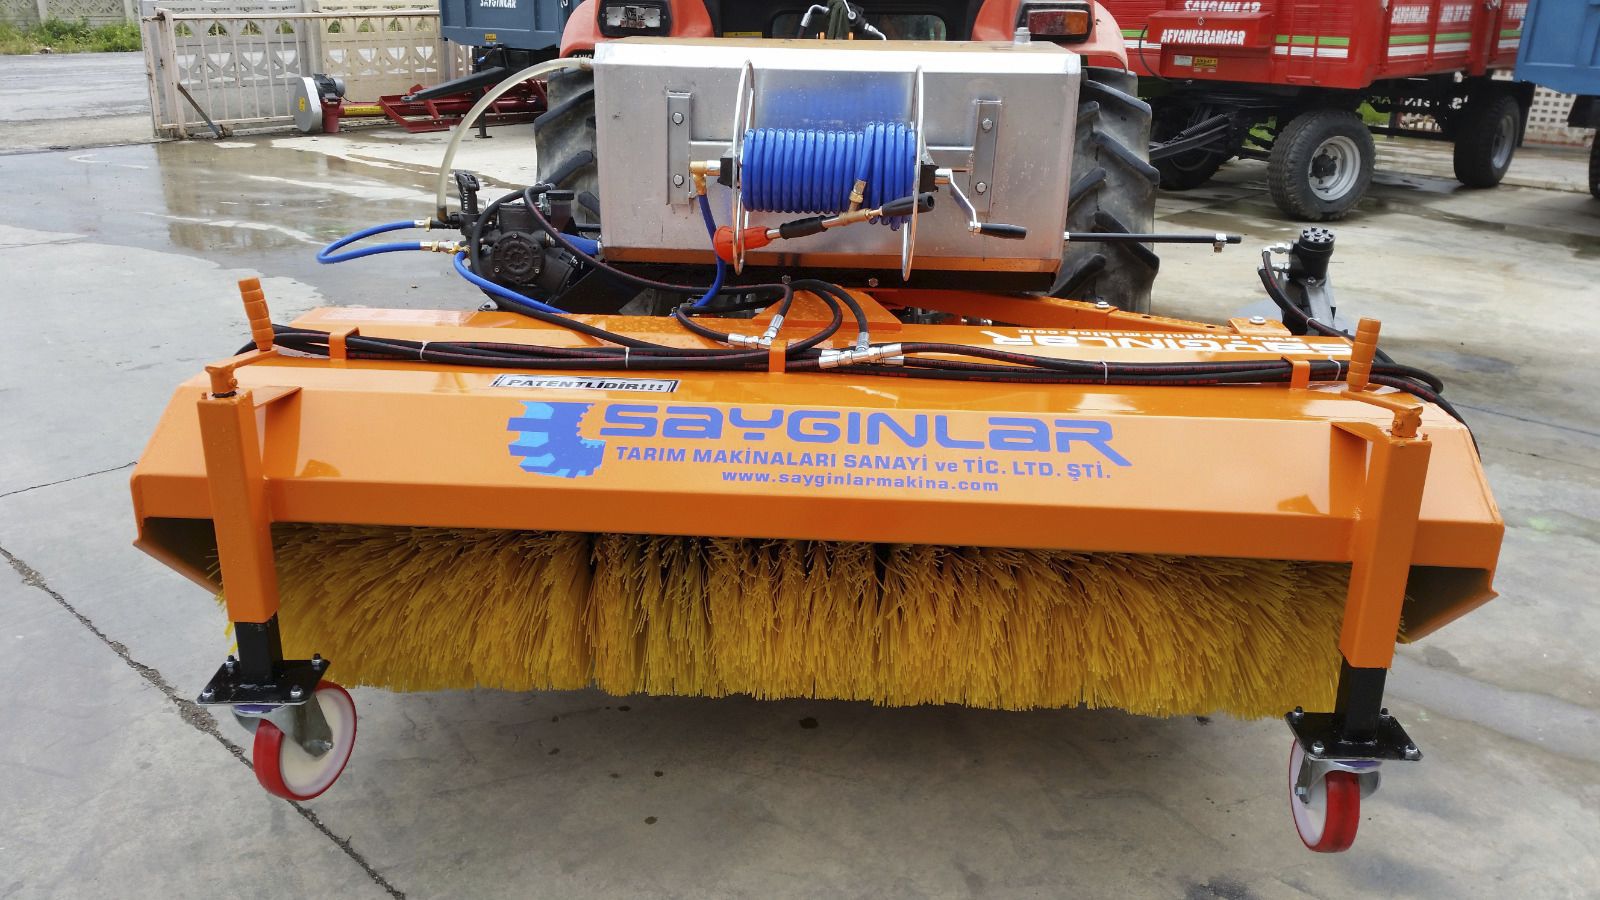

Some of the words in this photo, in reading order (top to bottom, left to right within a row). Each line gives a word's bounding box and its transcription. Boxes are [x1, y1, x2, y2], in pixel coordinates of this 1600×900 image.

[616, 446, 687, 462] TARIM
[693, 448, 837, 468] MAKİNALARI
[843, 453, 928, 471] SANAYİ
[935, 461, 959, 473] ve
[963, 458, 1007, 475] TİC.
[1012, 461, 1062, 477] LTD.
[1066, 462, 1111, 481] ŞTİ.
[722, 471, 999, 491] www.sayginlarmakina.com
